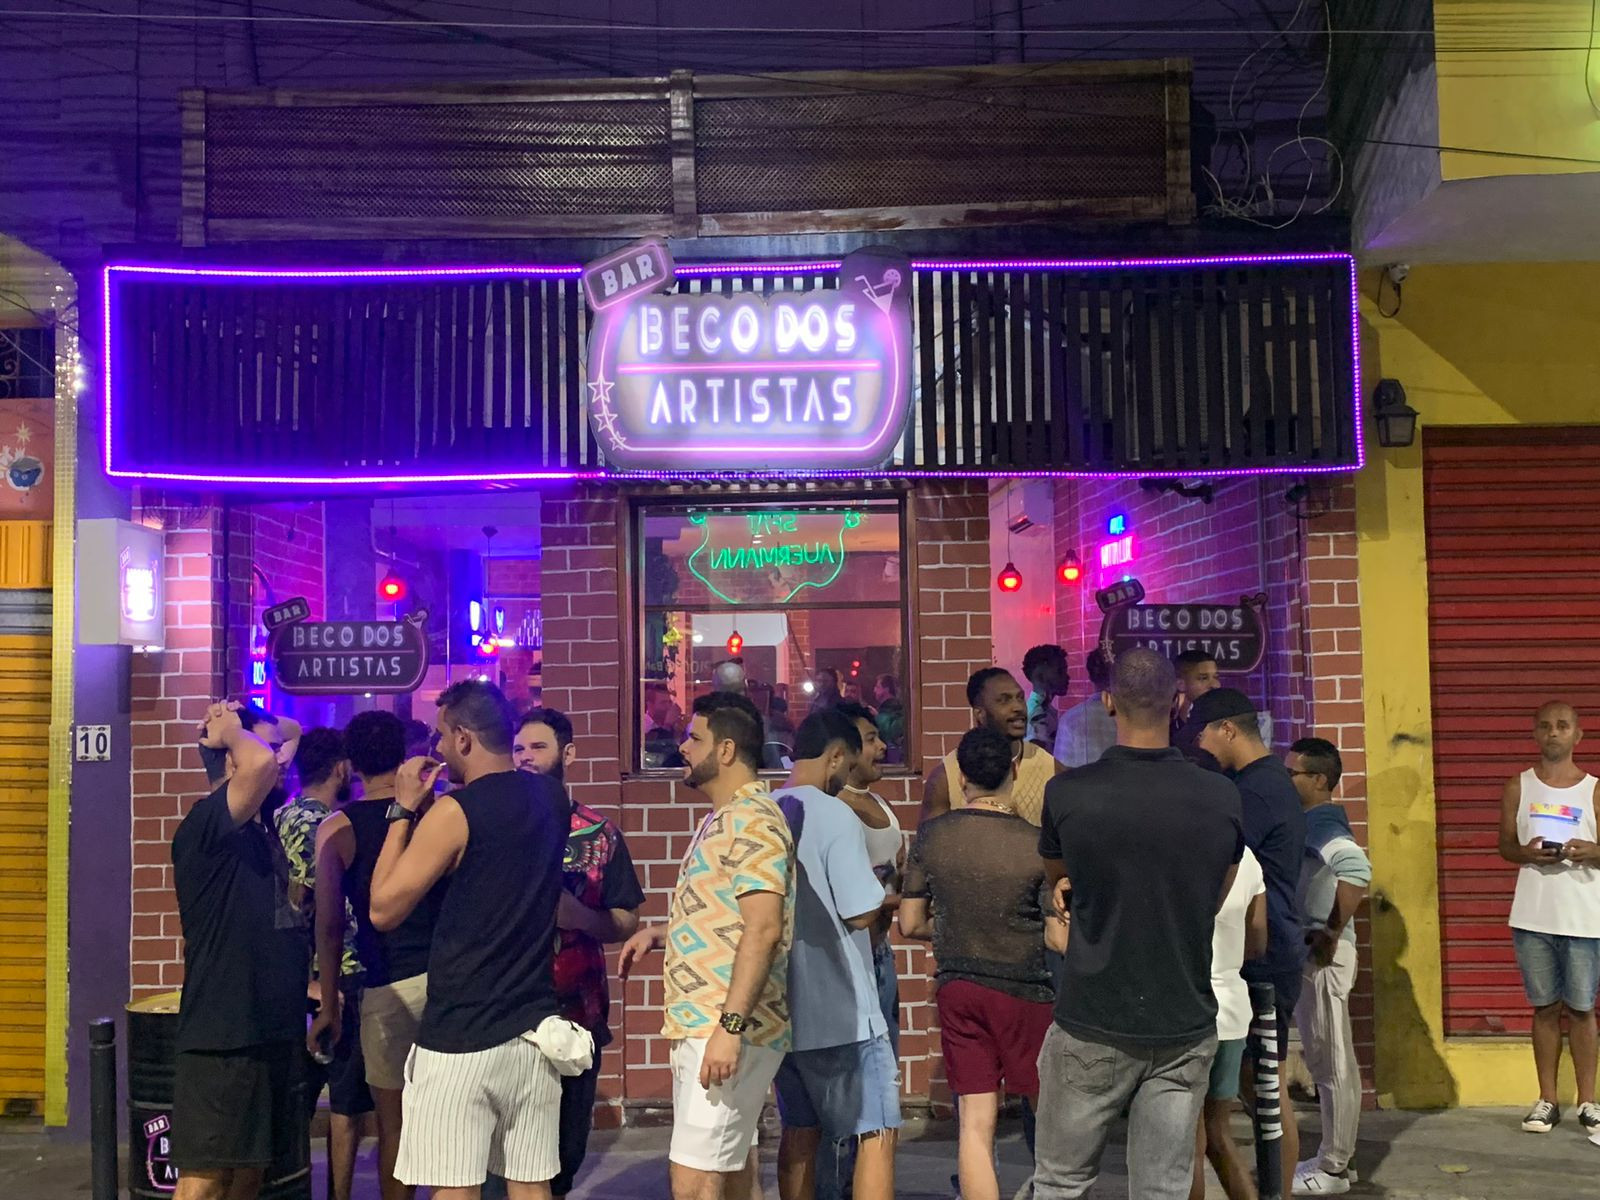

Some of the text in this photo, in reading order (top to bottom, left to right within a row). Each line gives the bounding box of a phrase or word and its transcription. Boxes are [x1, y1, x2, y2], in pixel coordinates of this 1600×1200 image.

[600, 253, 656, 297] BAR
[640, 304, 857, 354] BECO DOS
[650, 377, 852, 424] ARTISTAS
[1107, 587, 1137, 605] BAR
[273, 605, 302, 623] BAR
[1127, 609, 1243, 631] BECO DOS
[293, 625, 404, 648] BECO DOS
[298, 656, 401, 678] ARTISTAS
[80, 732, 108, 754] 10
[148, 1119, 165, 1133] BAR
